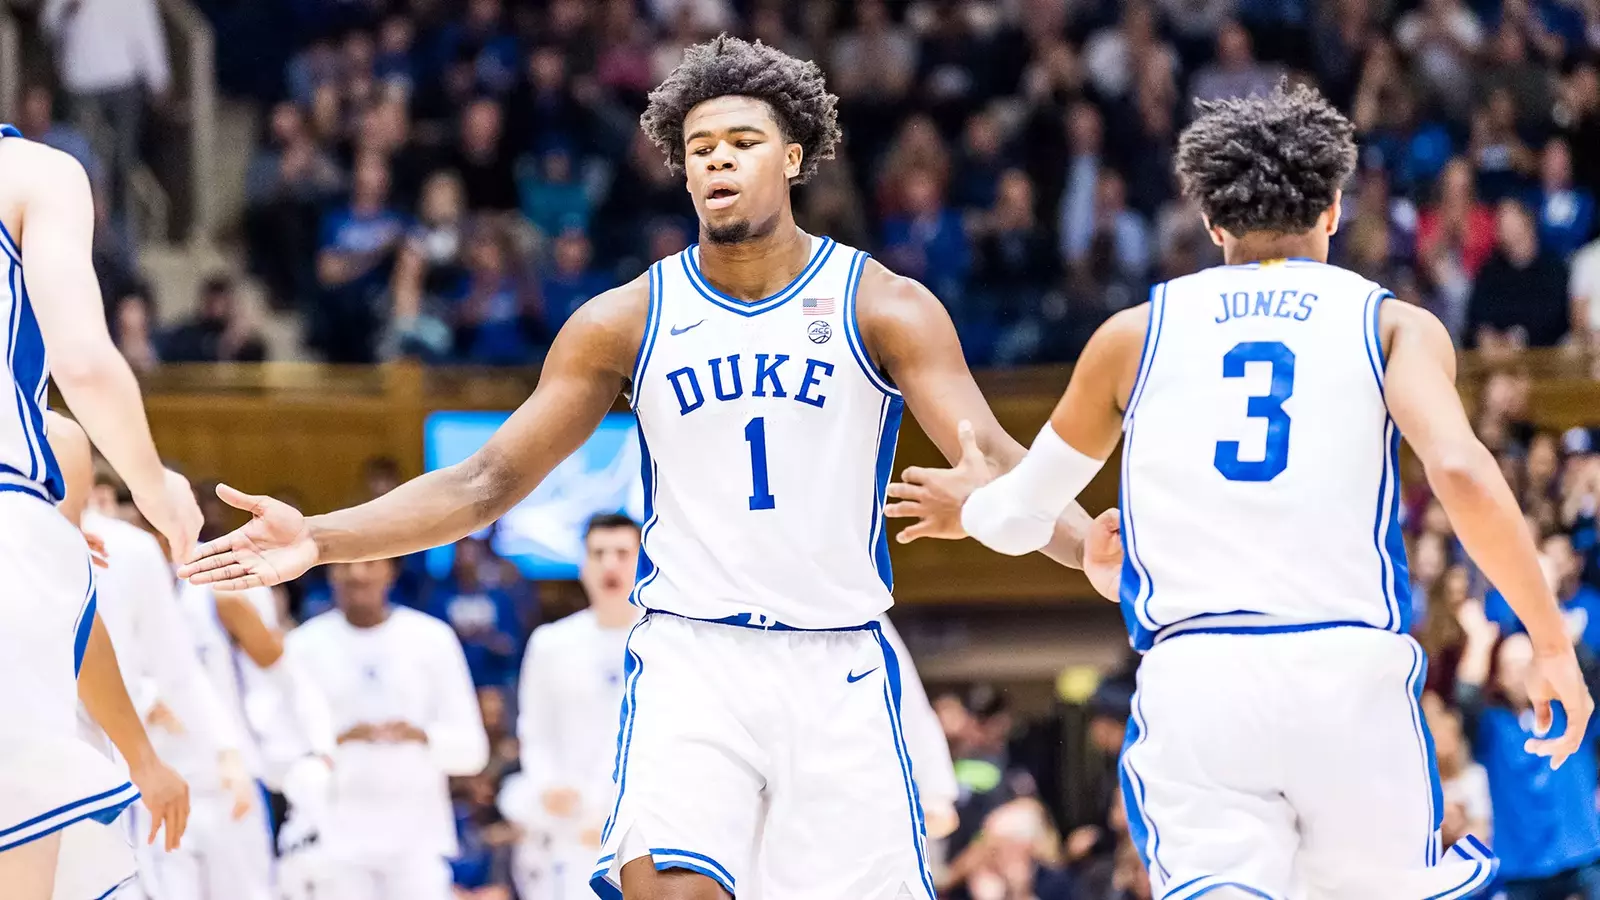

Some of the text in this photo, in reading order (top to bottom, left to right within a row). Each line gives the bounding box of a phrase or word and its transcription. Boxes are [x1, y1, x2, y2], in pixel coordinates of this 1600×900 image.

[1214, 290, 1319, 324] JONES
[665, 353, 835, 416] DUKE
[1213, 341, 1296, 482] 3
[744, 416, 776, 511] 1
